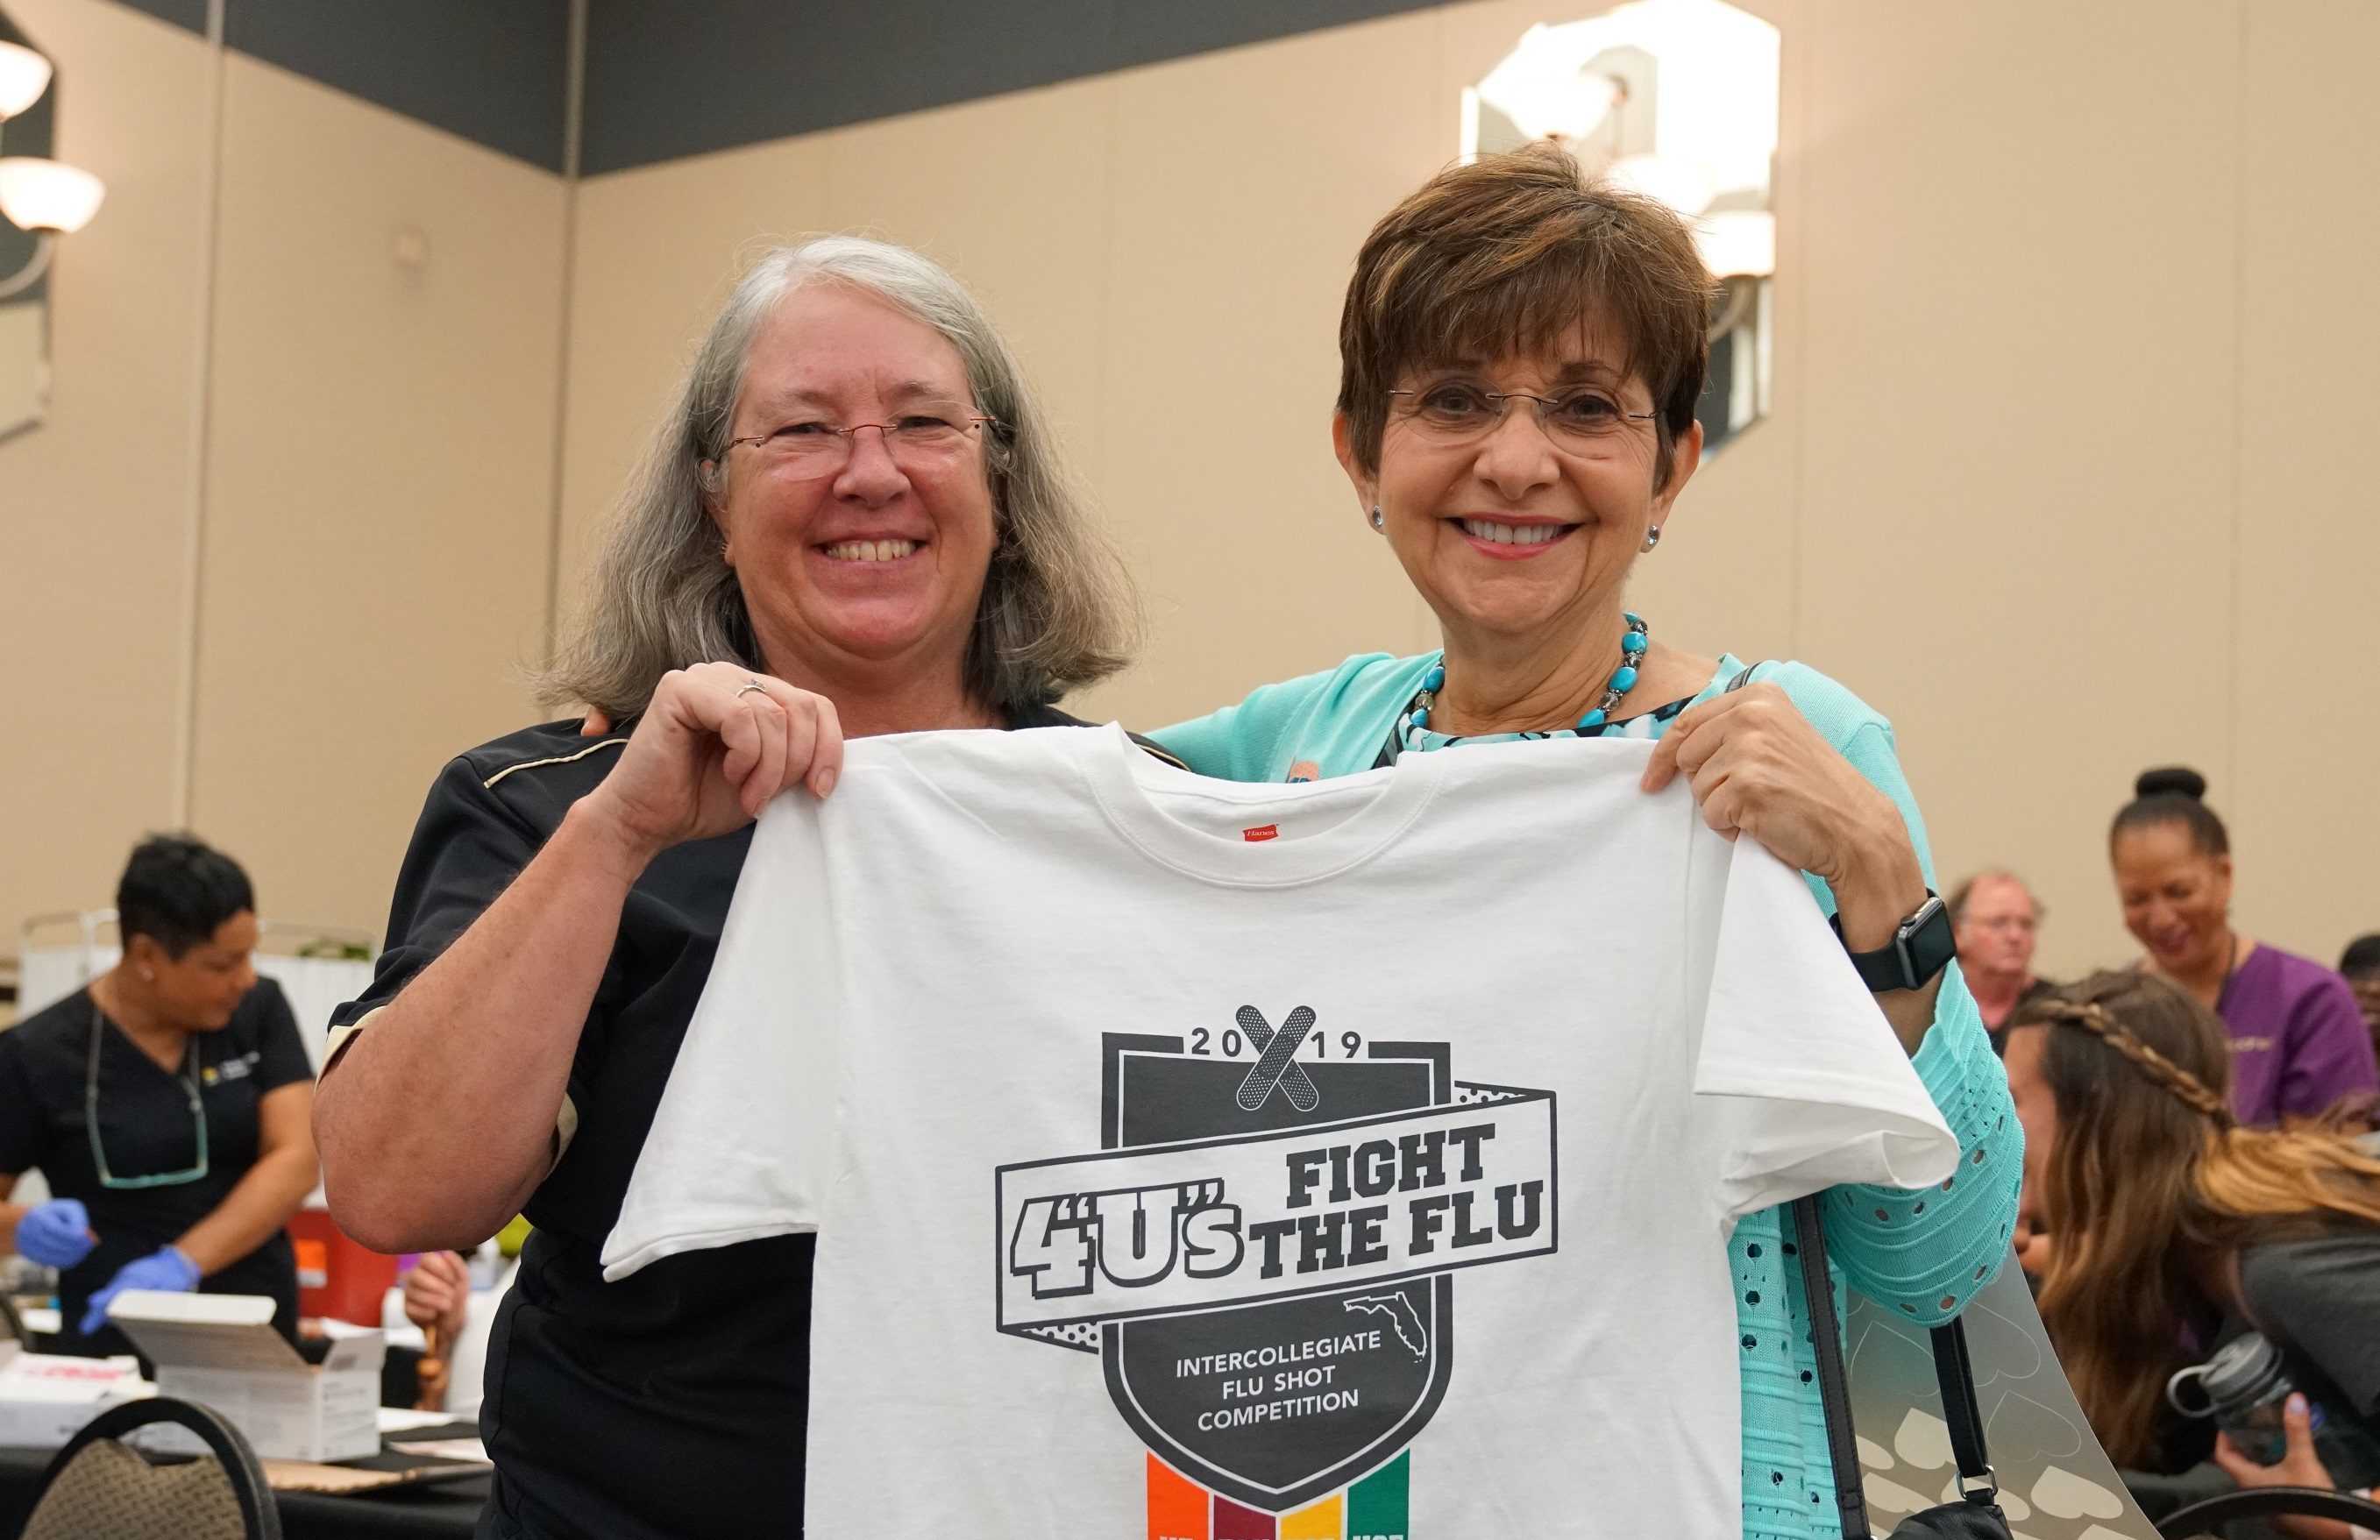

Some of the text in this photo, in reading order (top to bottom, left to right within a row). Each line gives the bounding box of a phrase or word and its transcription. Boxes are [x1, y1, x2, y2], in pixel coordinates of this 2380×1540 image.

[1286, 1123, 1495, 1209] FIGHT
[1249, 1180, 1543, 1280] THE FLU
[1176, 1330, 1381, 1378] INTERCOLLEGIATE
[1223, 1365, 1336, 1400] FLU SHOT
[1197, 1388, 1359, 1431] COMPETITION
